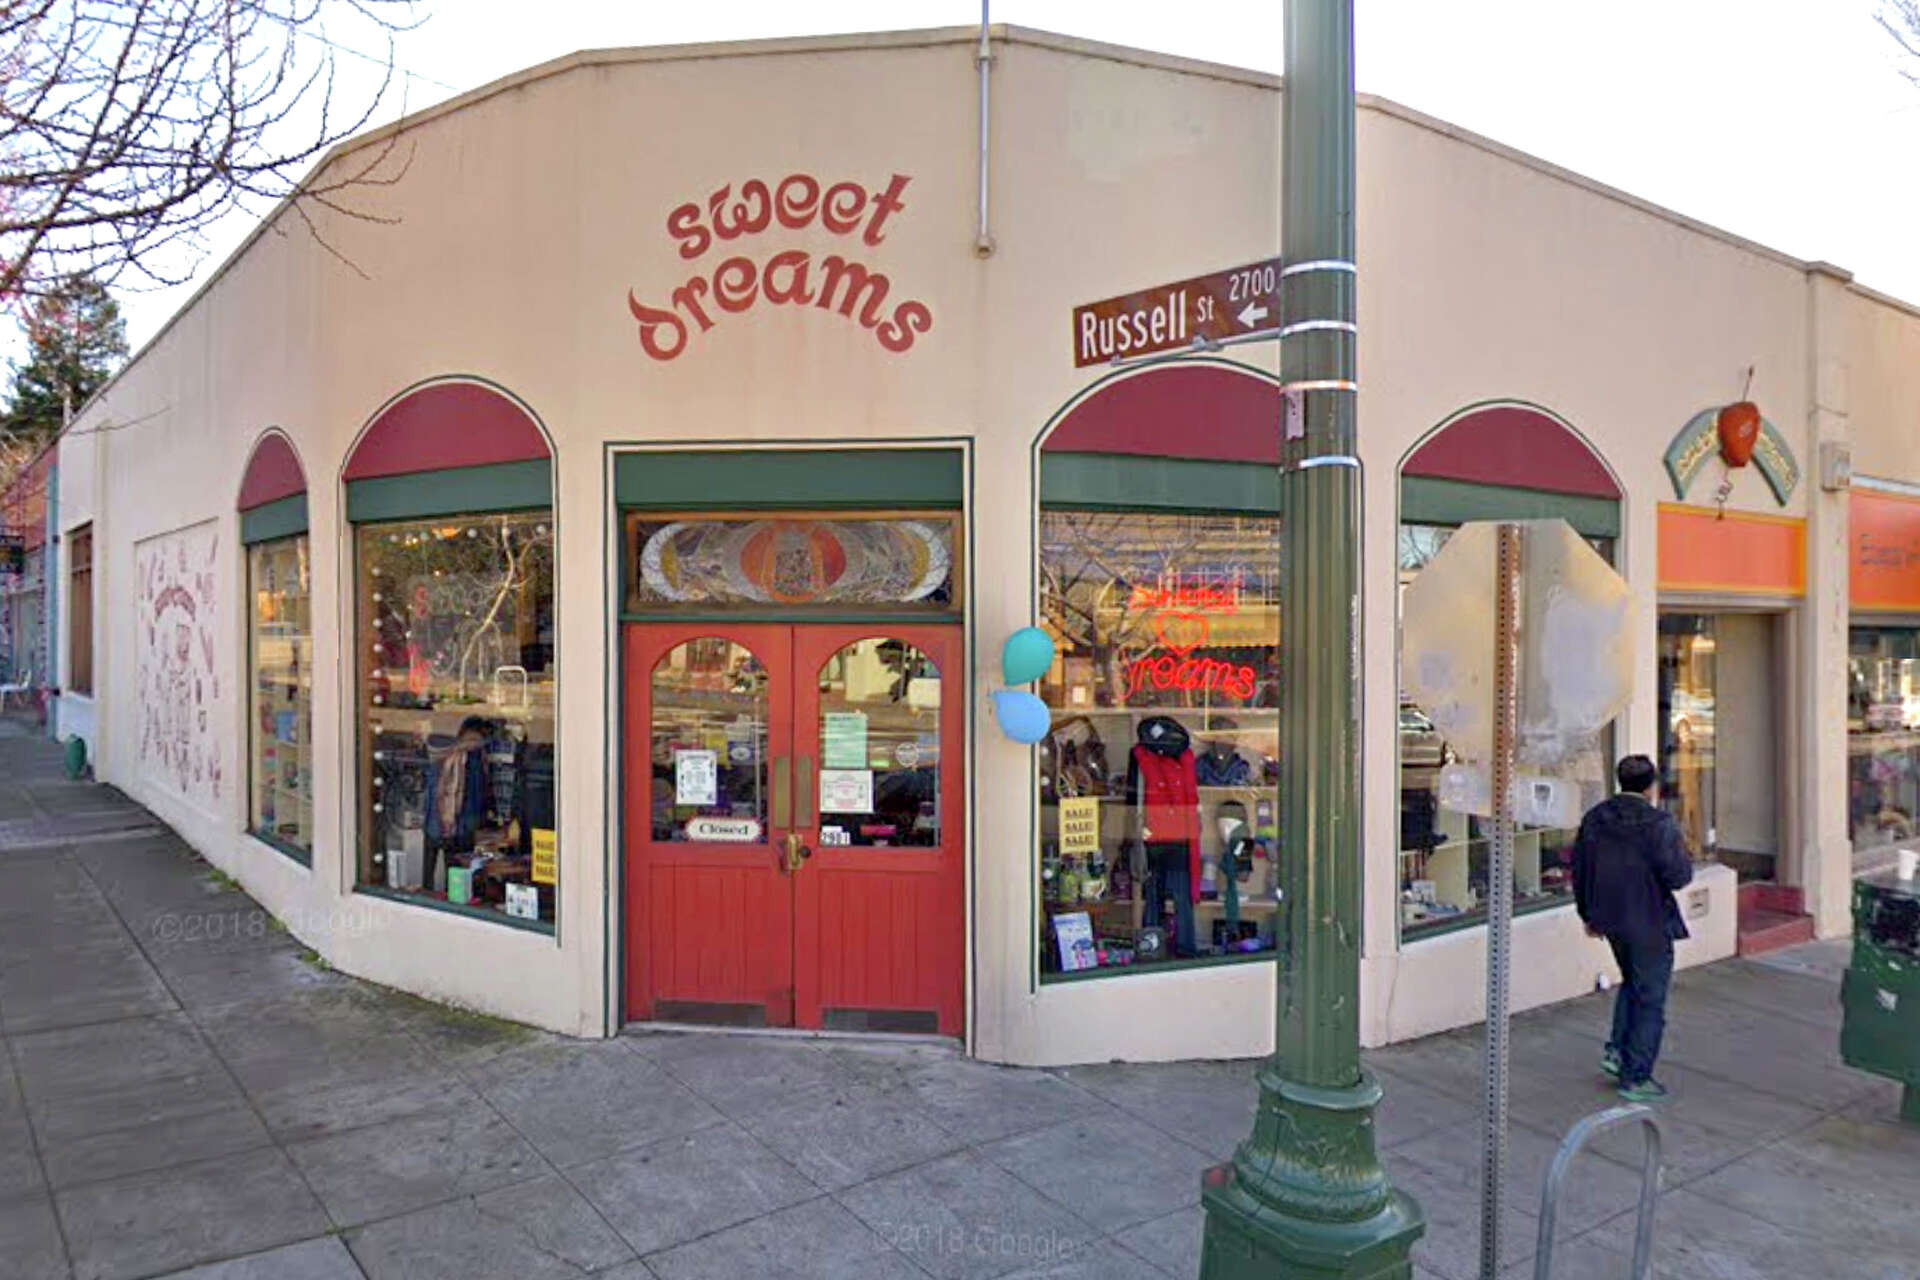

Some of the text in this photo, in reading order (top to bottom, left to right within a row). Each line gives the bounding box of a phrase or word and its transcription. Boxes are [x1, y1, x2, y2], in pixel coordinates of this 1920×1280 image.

[667, 174, 912, 260] sweet
[627, 249, 932, 361] dreams
[1228, 266, 1276, 302] 2700
[1080, 289, 1215, 360] Russell St
[699, 822, 749, 836] Closed
